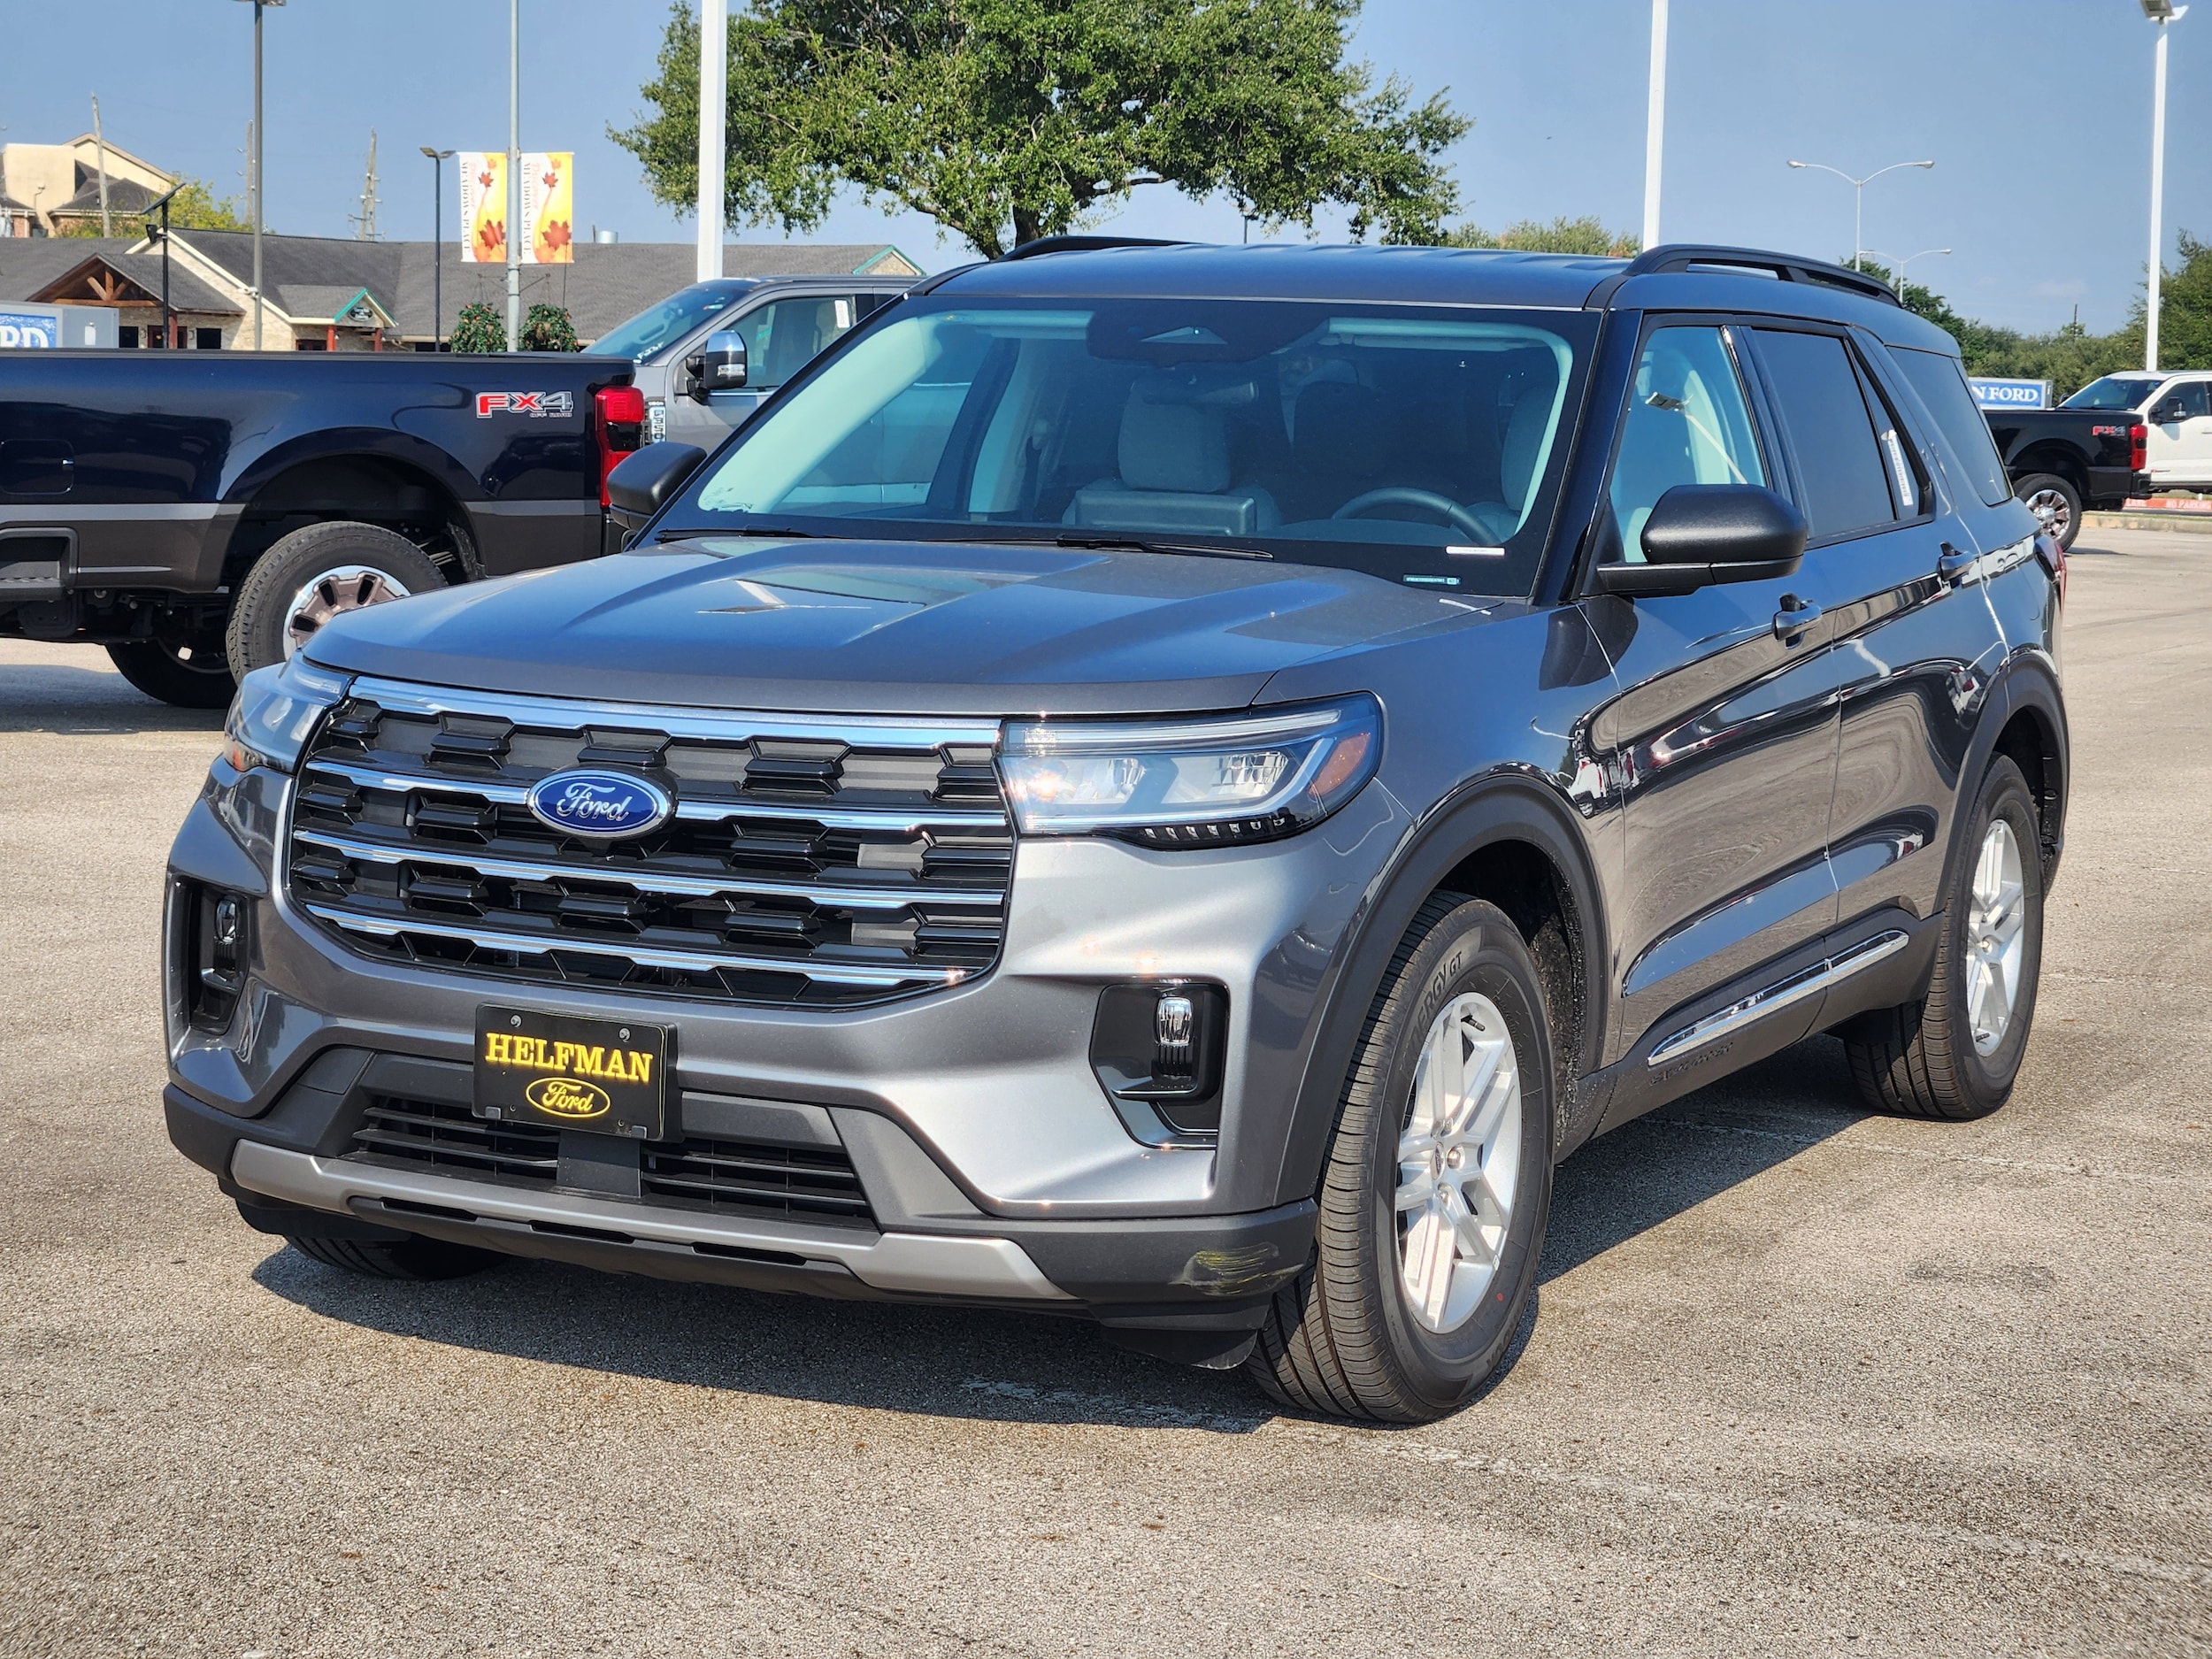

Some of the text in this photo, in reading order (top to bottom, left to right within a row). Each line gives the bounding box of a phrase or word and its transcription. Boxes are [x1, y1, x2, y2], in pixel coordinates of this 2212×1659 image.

[476, 391, 573, 418] FX4
[1988, 386, 2039, 403] FORD
[2093, 426, 2125, 436] FX4
[556, 782, 633, 822] Ford
[485, 1032, 653, 1083] HELFMAN
[541, 1080, 595, 1112] Ford
